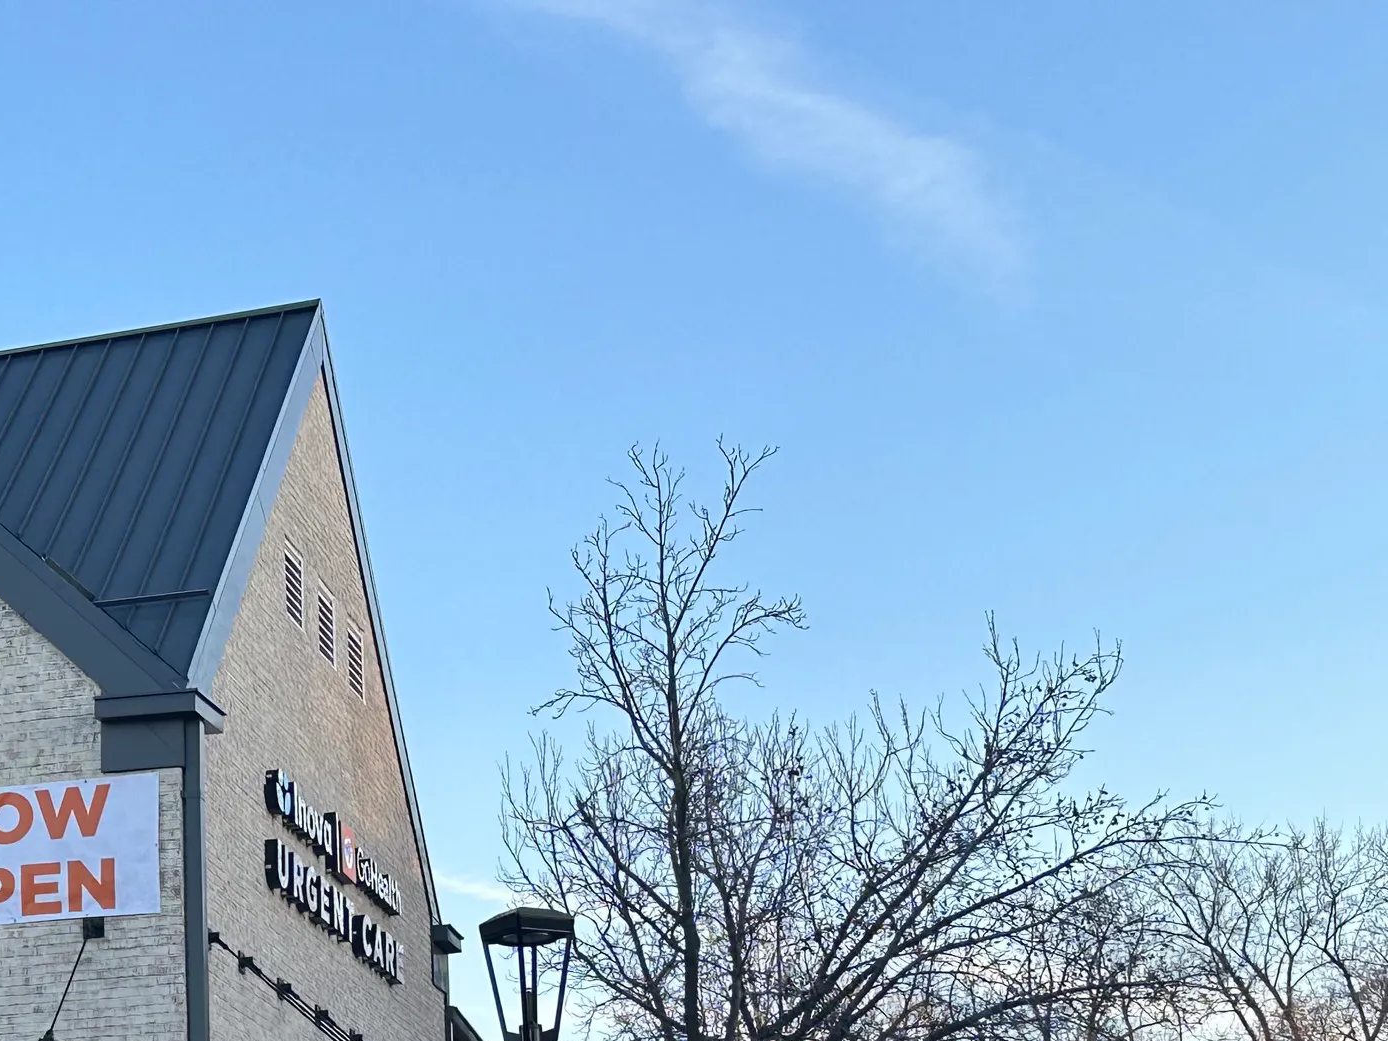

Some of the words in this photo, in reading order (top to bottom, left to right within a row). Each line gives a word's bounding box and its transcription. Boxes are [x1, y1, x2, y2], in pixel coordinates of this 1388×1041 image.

[293, 781, 334, 856] Inova
[276, 838, 355, 944] URGENT
[361, 912, 405, 986] CARE
[356, 846, 402, 916] GoHealth
